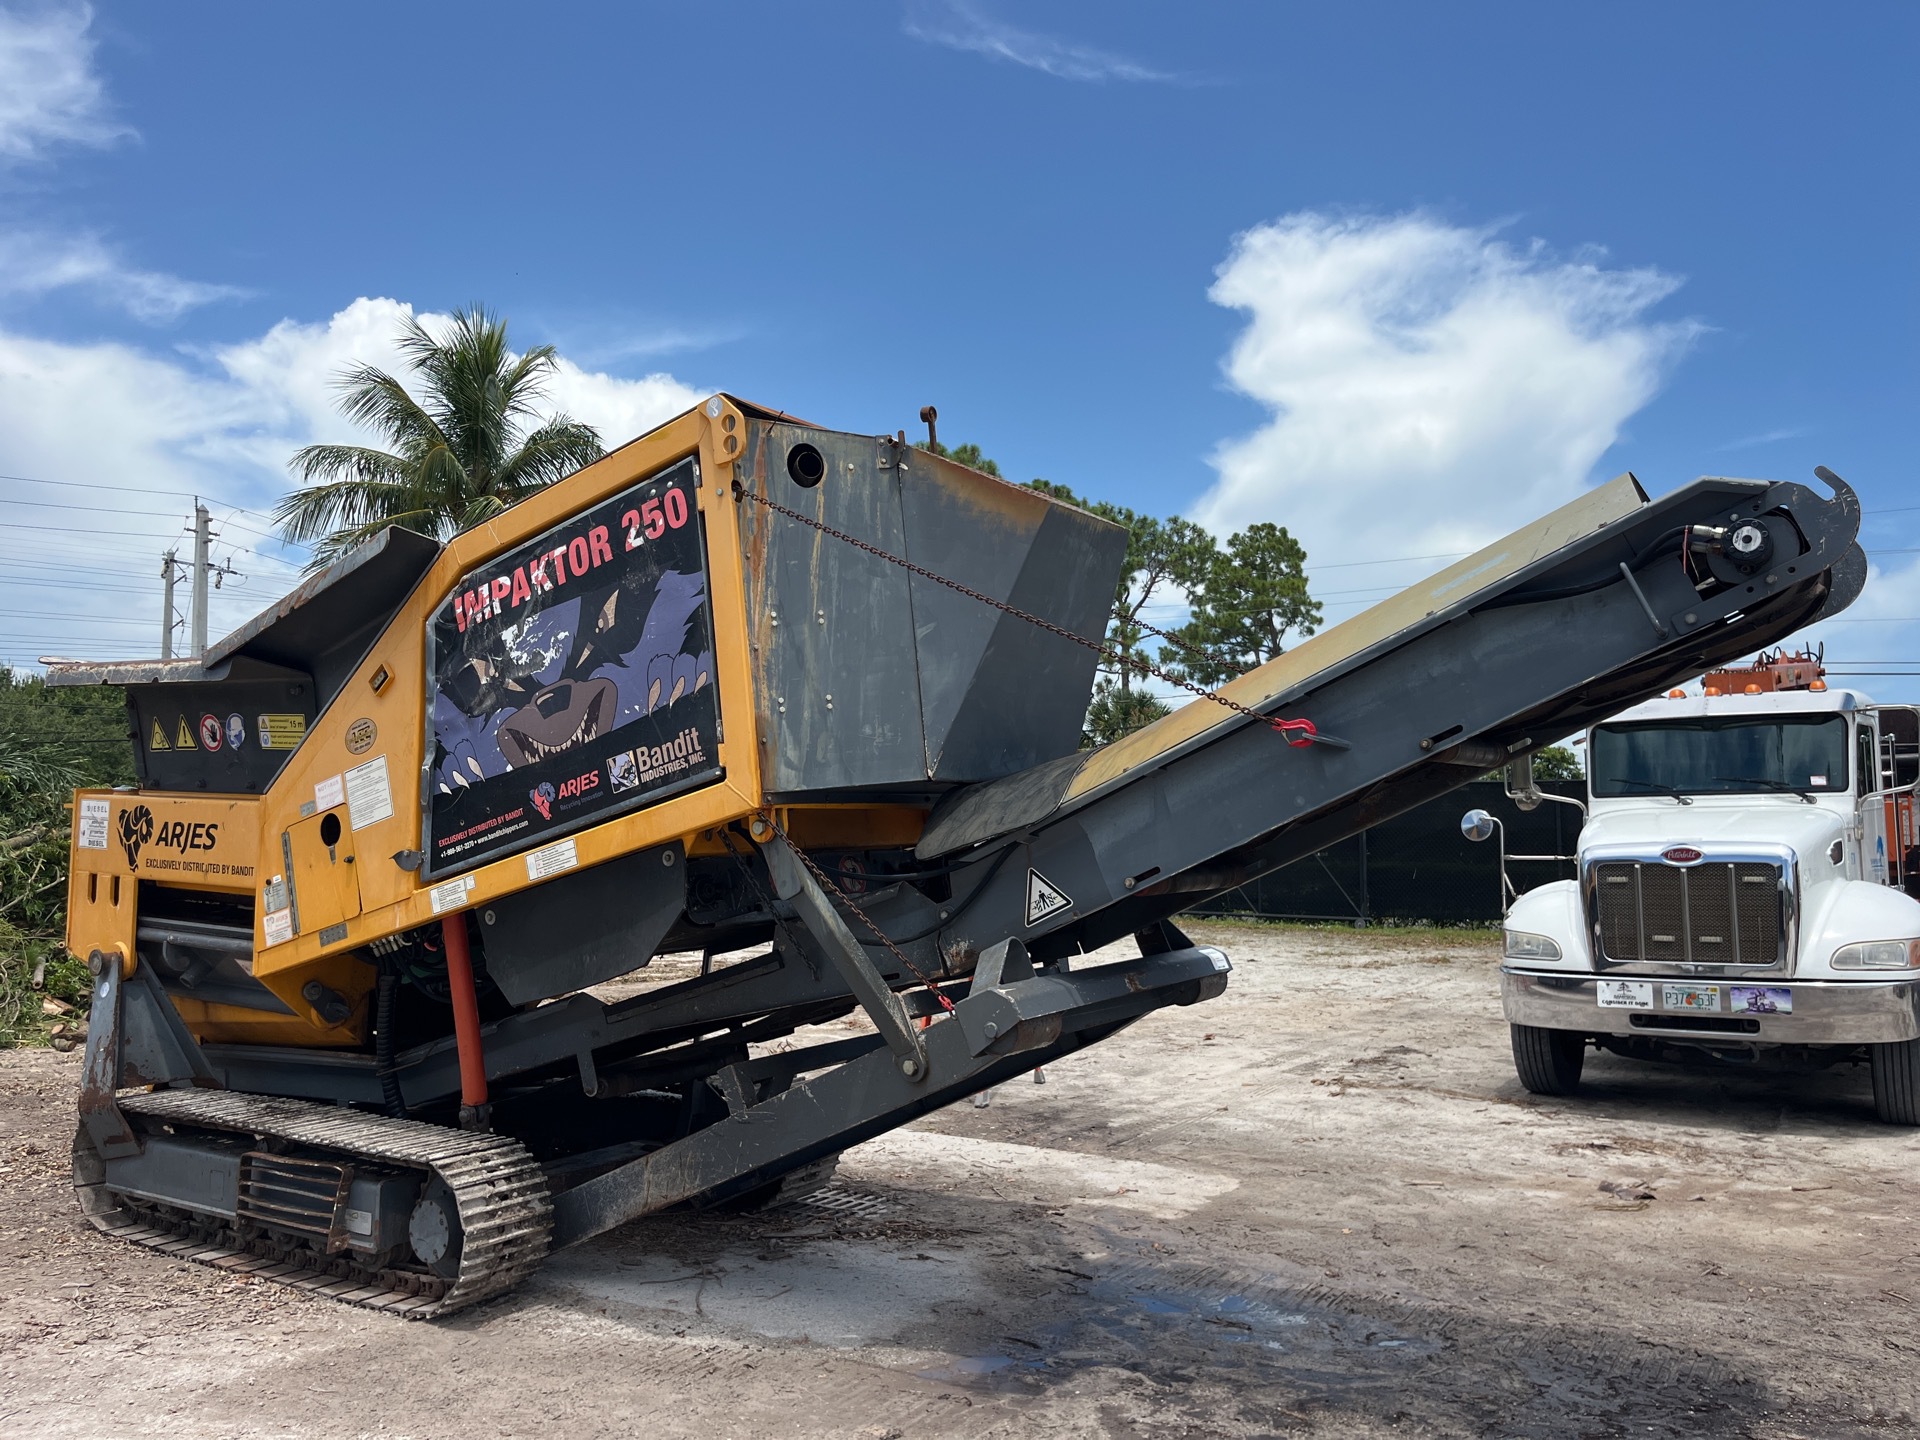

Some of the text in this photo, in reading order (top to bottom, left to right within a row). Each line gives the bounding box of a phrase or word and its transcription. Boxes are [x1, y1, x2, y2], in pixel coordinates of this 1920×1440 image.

[454, 487, 688, 633] IMPAKTOR 250
[290, 720, 297, 728] 15
[636, 727, 701, 772] Bandit
[640, 751, 706, 783] INDUSTRIES, INC.
[558, 770, 599, 800] ARJES
[155, 821, 219, 855] ARJES
[438, 807, 524, 848] EXCLUSIVELY DISTRIBUTED BY BANDIT
[145, 858, 182, 871] EXCLUSIVELY
[221, 864, 231, 875] BY
[231, 865, 255, 877] BANDIT
